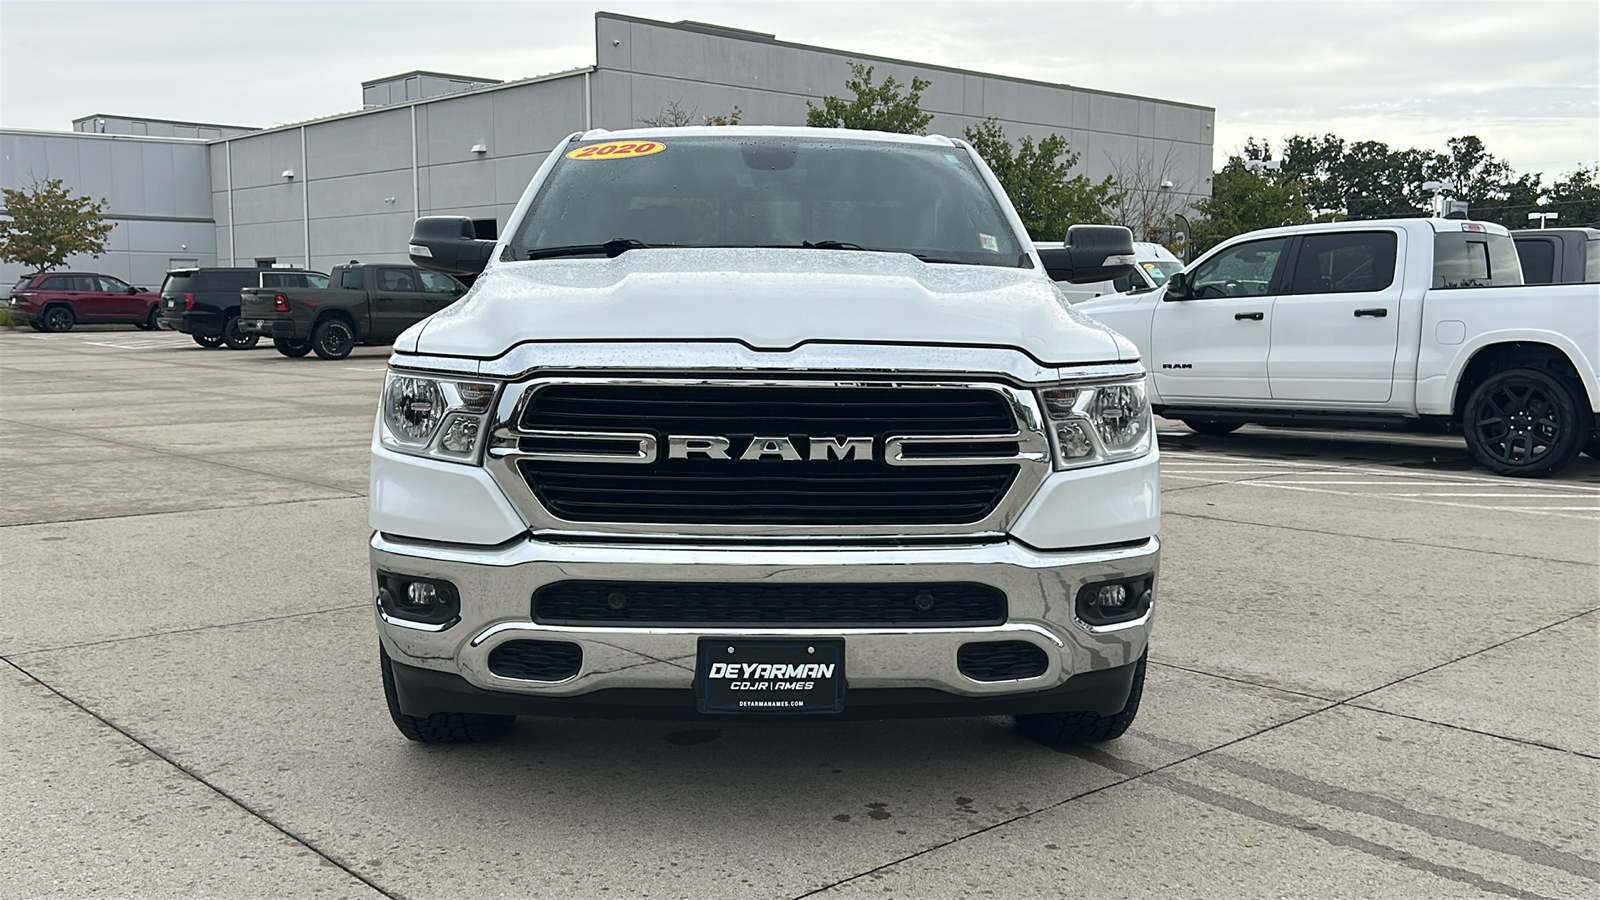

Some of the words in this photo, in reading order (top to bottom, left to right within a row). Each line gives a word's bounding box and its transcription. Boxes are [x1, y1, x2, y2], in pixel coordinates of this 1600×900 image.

[575, 143, 656, 158] 2020
[668, 435, 874, 461] RAM
[709, 663, 835, 679] DEYARMAN
[774, 681, 815, 690] AMES
